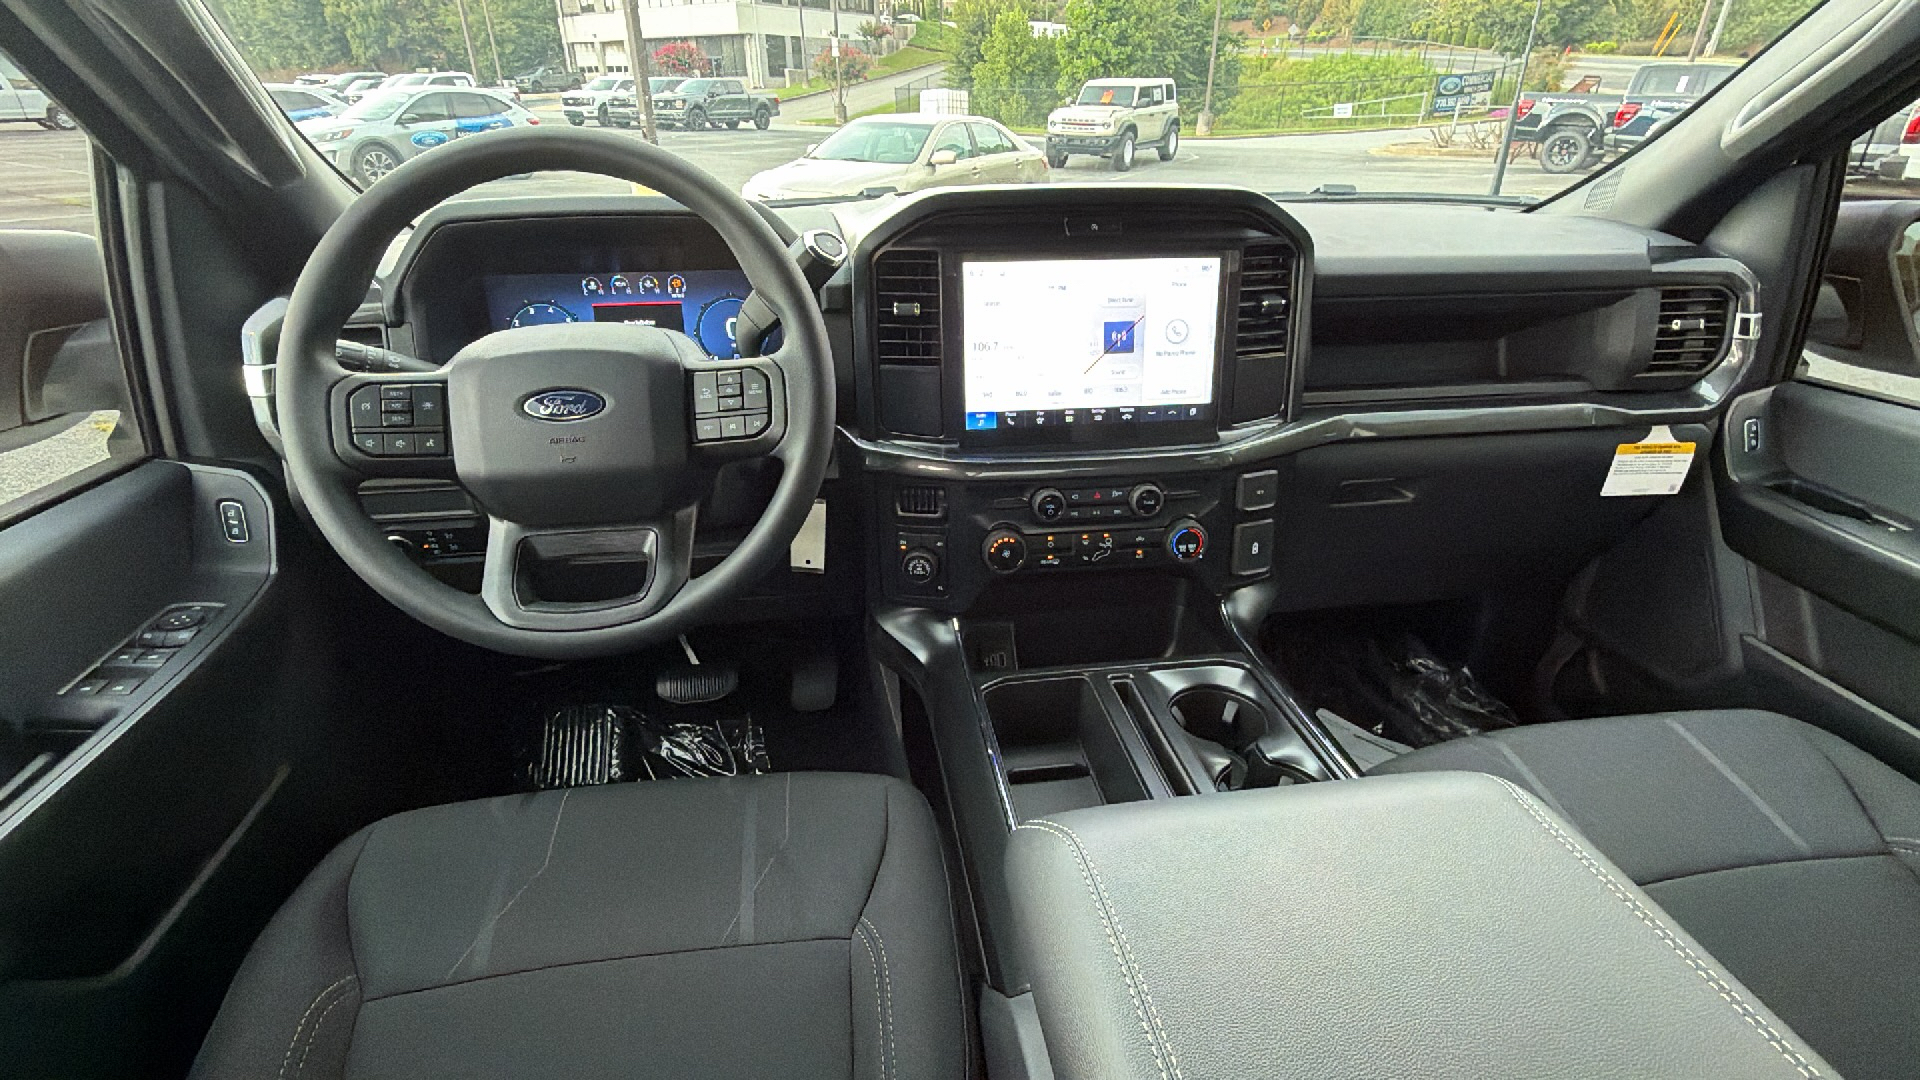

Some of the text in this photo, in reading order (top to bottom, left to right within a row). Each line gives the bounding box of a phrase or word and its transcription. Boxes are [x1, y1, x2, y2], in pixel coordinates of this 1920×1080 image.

[973, 341, 999, 352] 106.7
[539, 395, 588, 416] Ford
[549, 436, 586, 445] AIRBAG
